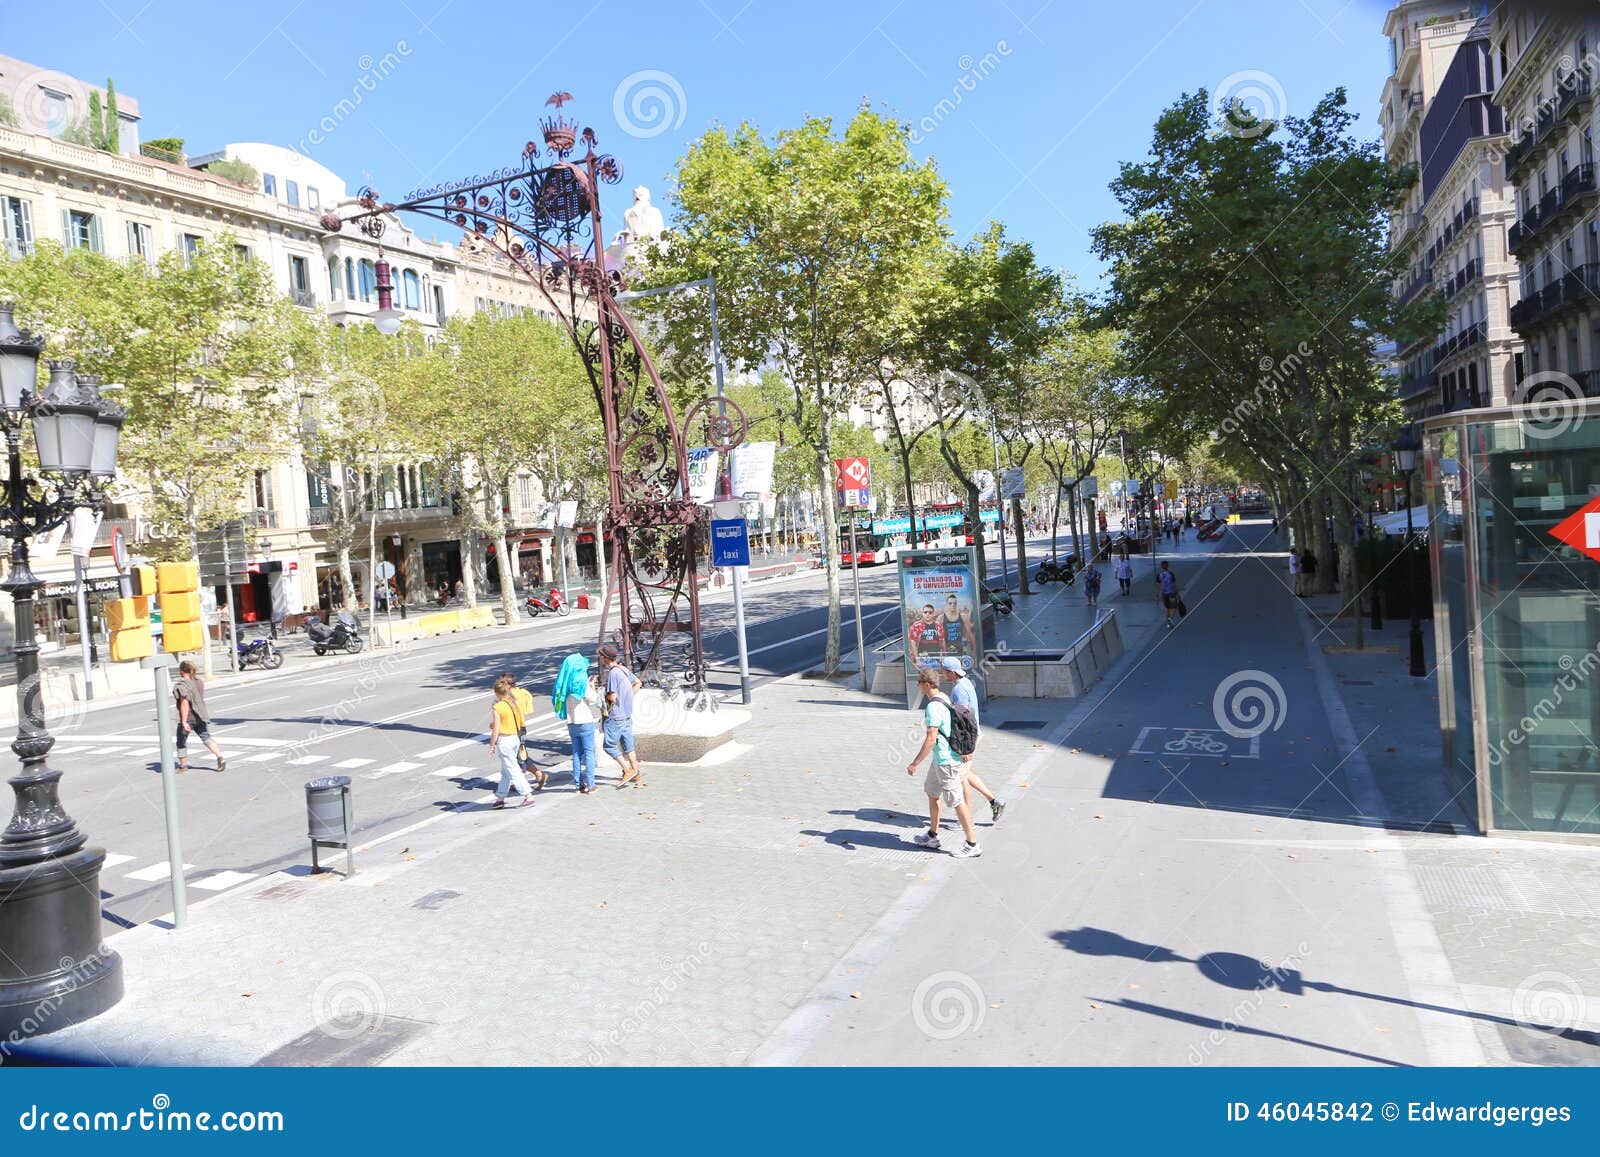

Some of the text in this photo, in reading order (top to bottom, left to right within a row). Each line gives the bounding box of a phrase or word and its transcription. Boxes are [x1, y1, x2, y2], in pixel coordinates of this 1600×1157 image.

[853, 465, 862, 476] M
[723, 550, 739, 559] taxi
[935, 554, 967, 563] Diagonal
